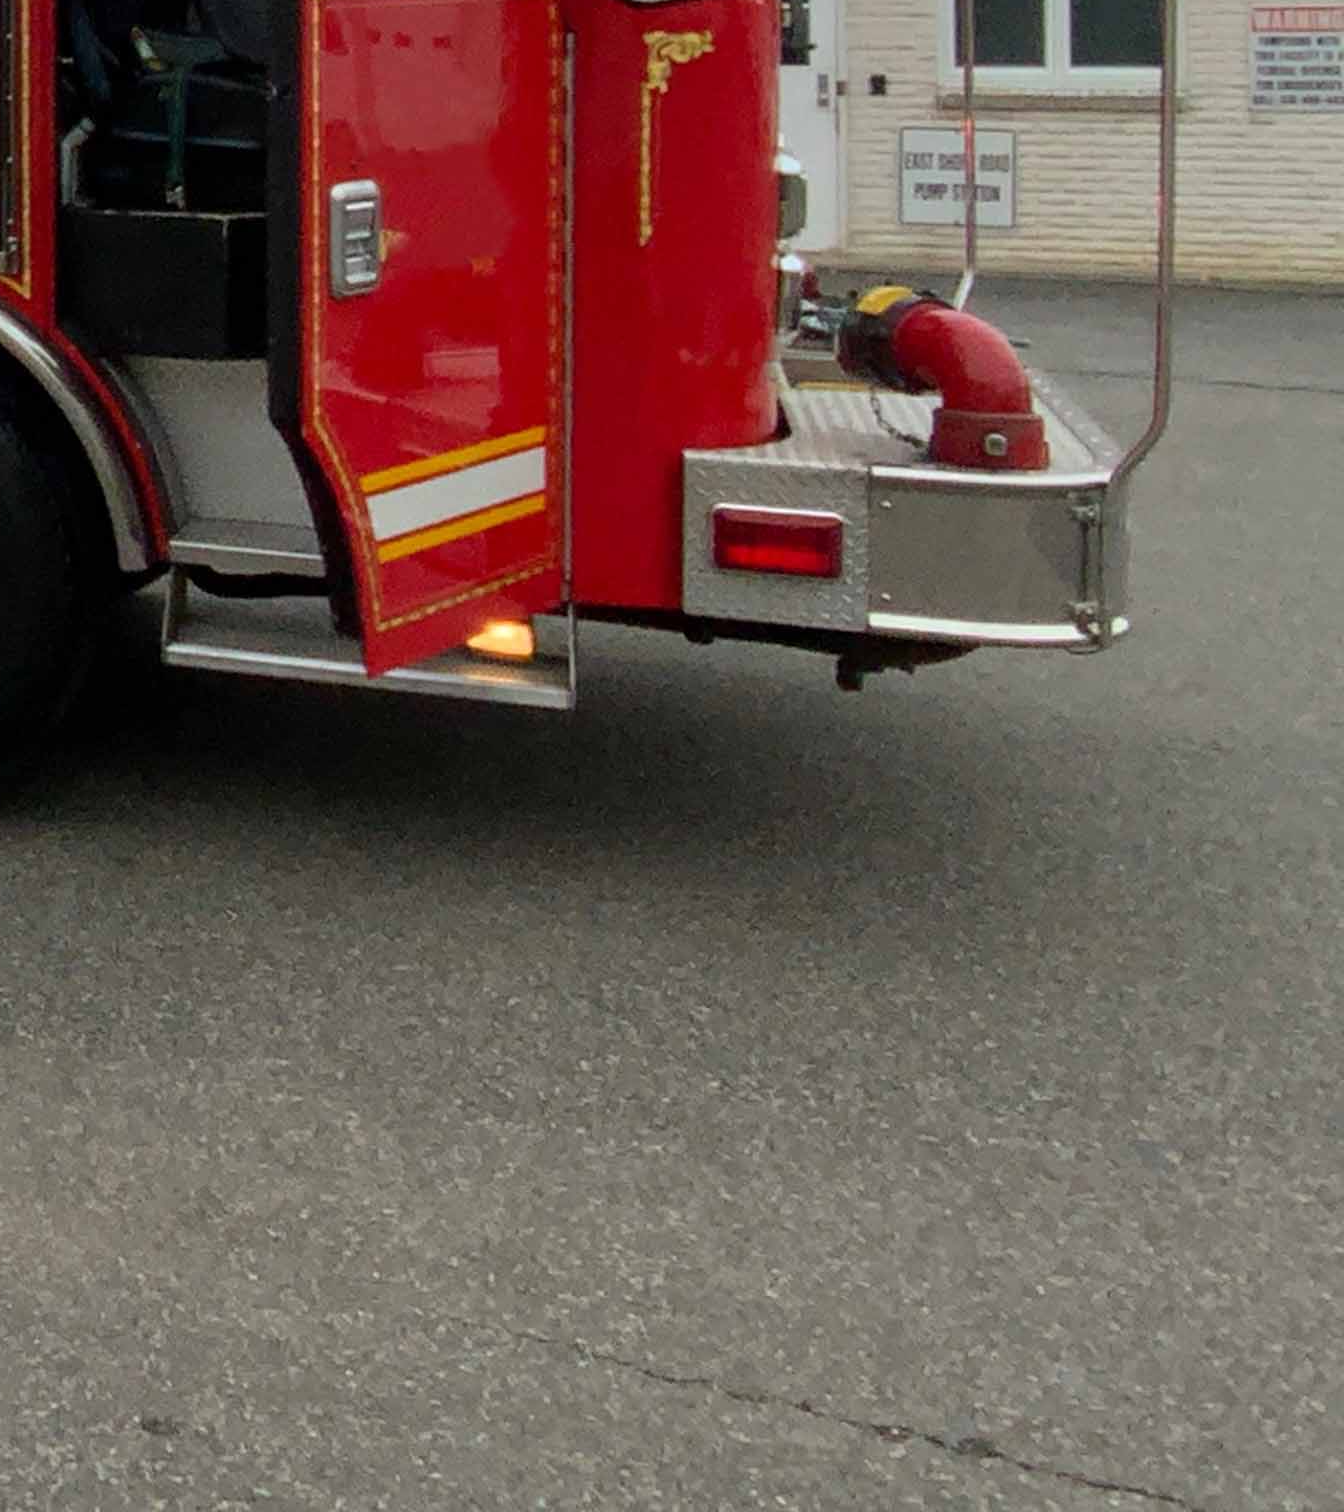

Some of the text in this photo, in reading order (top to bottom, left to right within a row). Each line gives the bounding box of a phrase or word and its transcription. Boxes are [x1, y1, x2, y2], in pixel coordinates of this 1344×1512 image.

[904, 152, 934, 169] EAST
[979, 153, 1009, 172] ROAD
[914, 183, 1000, 201] PUMP STTION
